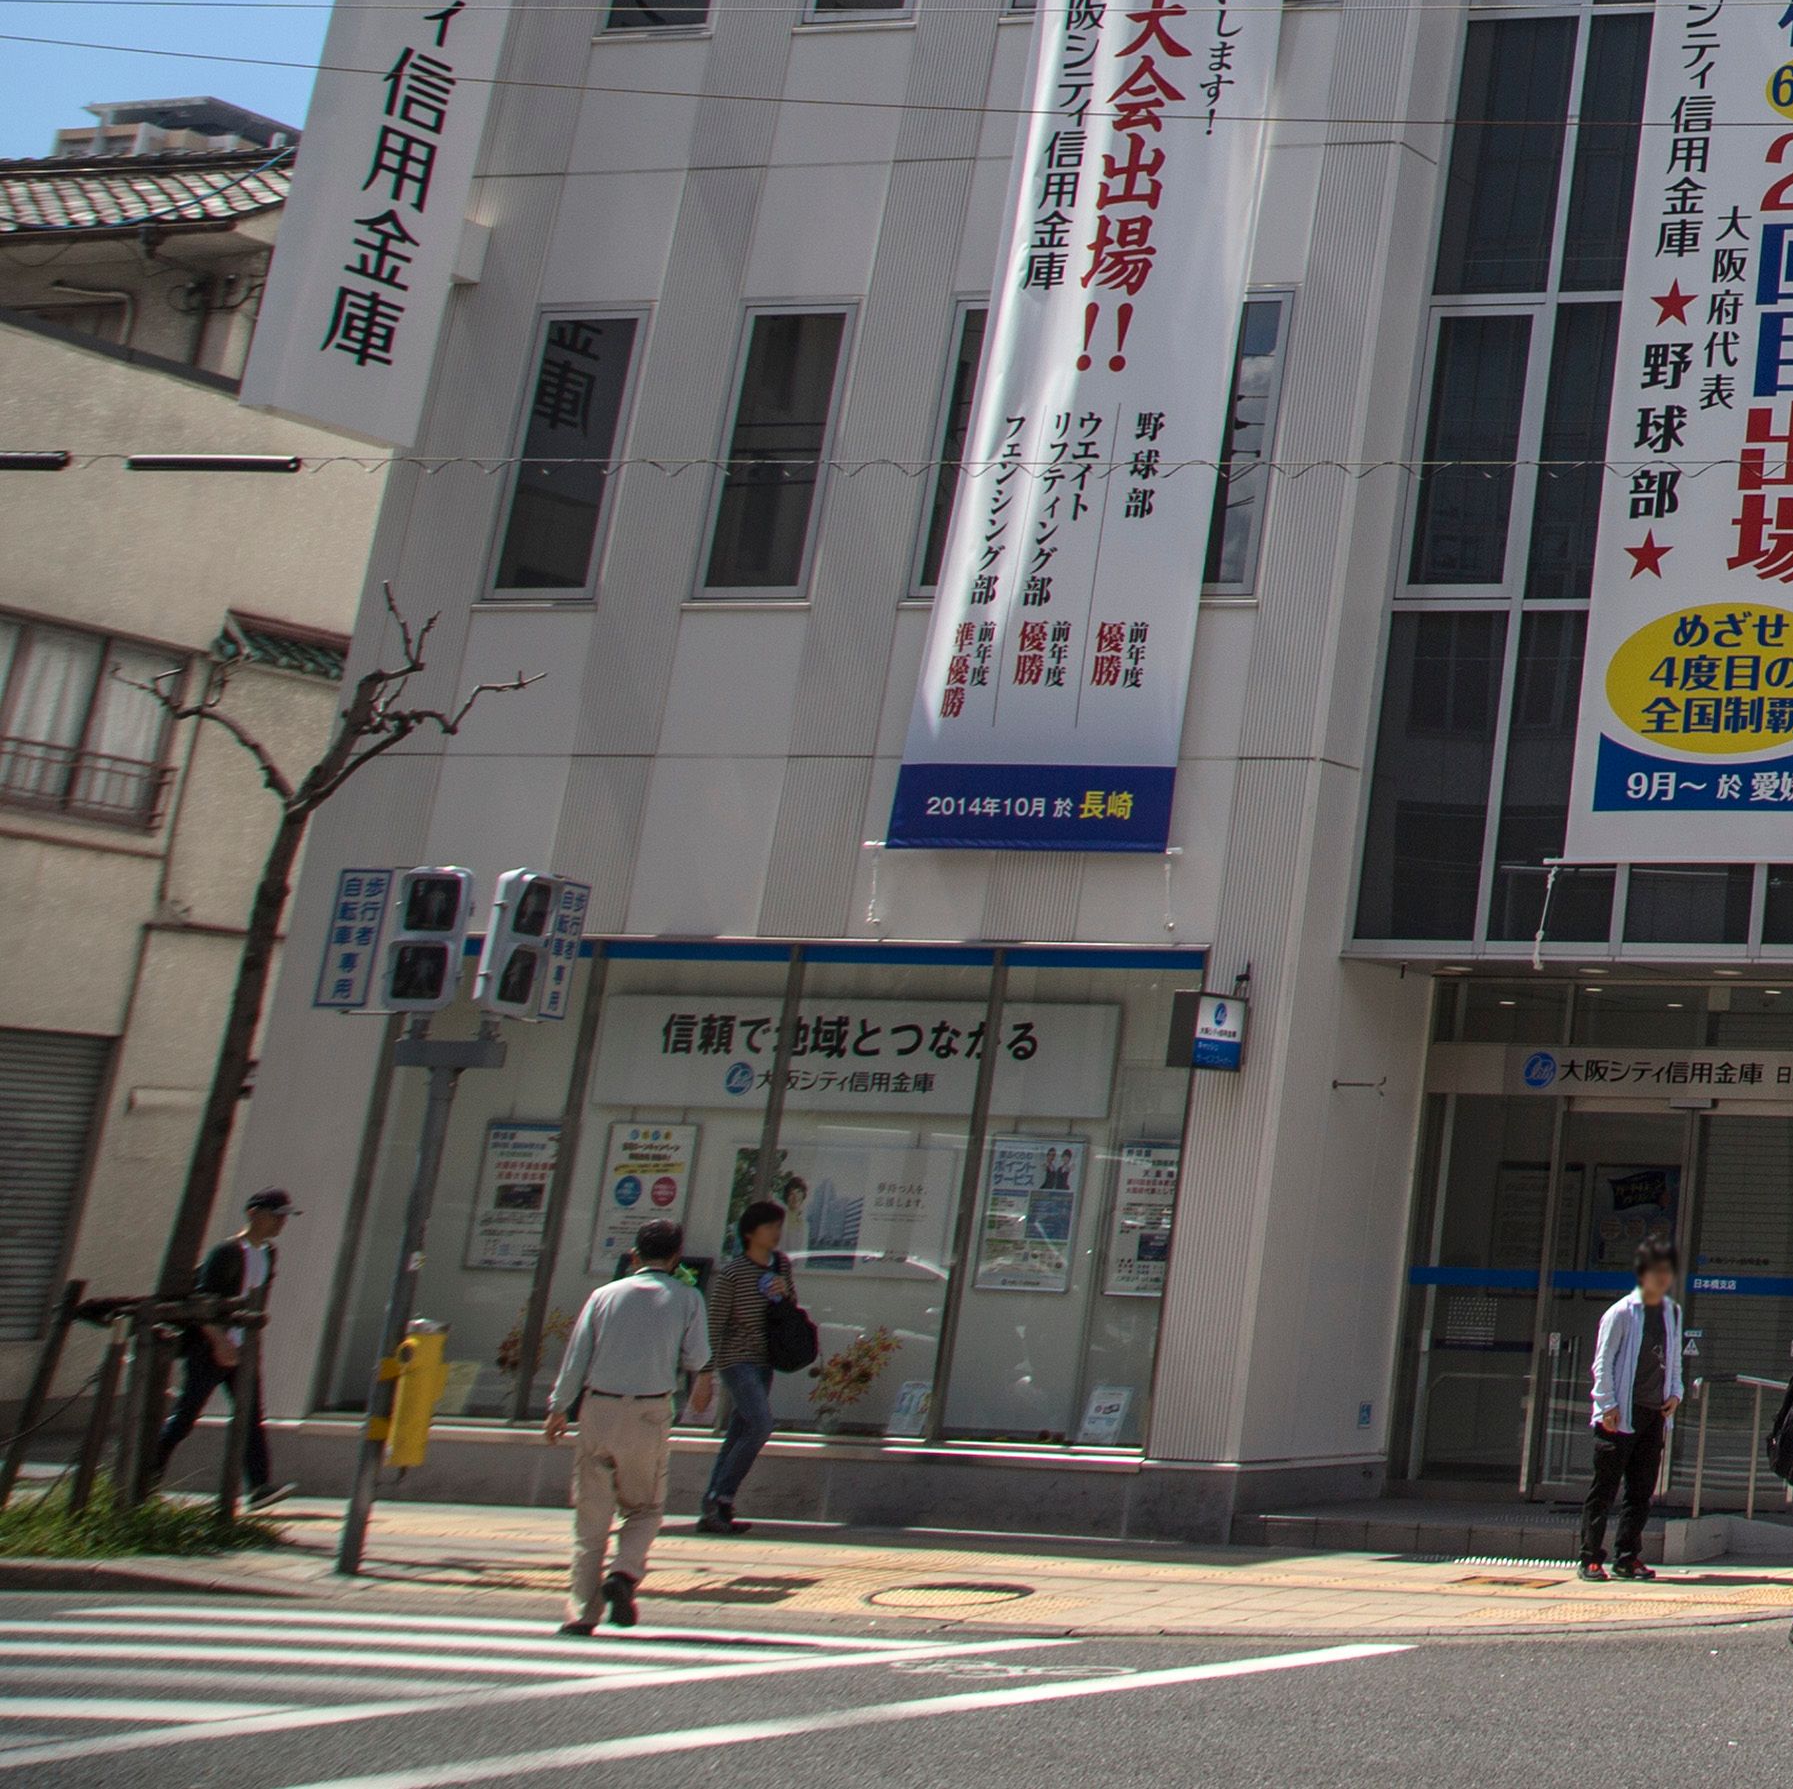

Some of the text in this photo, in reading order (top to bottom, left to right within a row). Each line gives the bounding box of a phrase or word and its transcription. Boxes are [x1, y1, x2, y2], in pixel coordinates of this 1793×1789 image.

[1699, 206, 1751, 411] 大阪府代表
[1629, 341, 1693, 518] 野球部
[1123, 412, 1166, 519] 野球部
[969, 415, 1027, 605] フェンシング部
[969, 621, 997, 687] 前年度
[1014, 620, 1047, 687] 優勝
[1045, 620, 1072, 688] 前年度
[1090, 620, 1124, 688] 優勝
[1122, 621, 1149, 689] 前年度
[1673, 612, 1789, 648] めざせ
[940, 621, 975, 719] 準優勝
[926, 789, 1134, 821] 2014年10月 於 長崎
[1717, 774, 1742, 801] 於
[1559, 1059, 1764, 1084] 大阪シティ信用金庫
[1694, 1279, 1737, 1290] 日本橋支店
